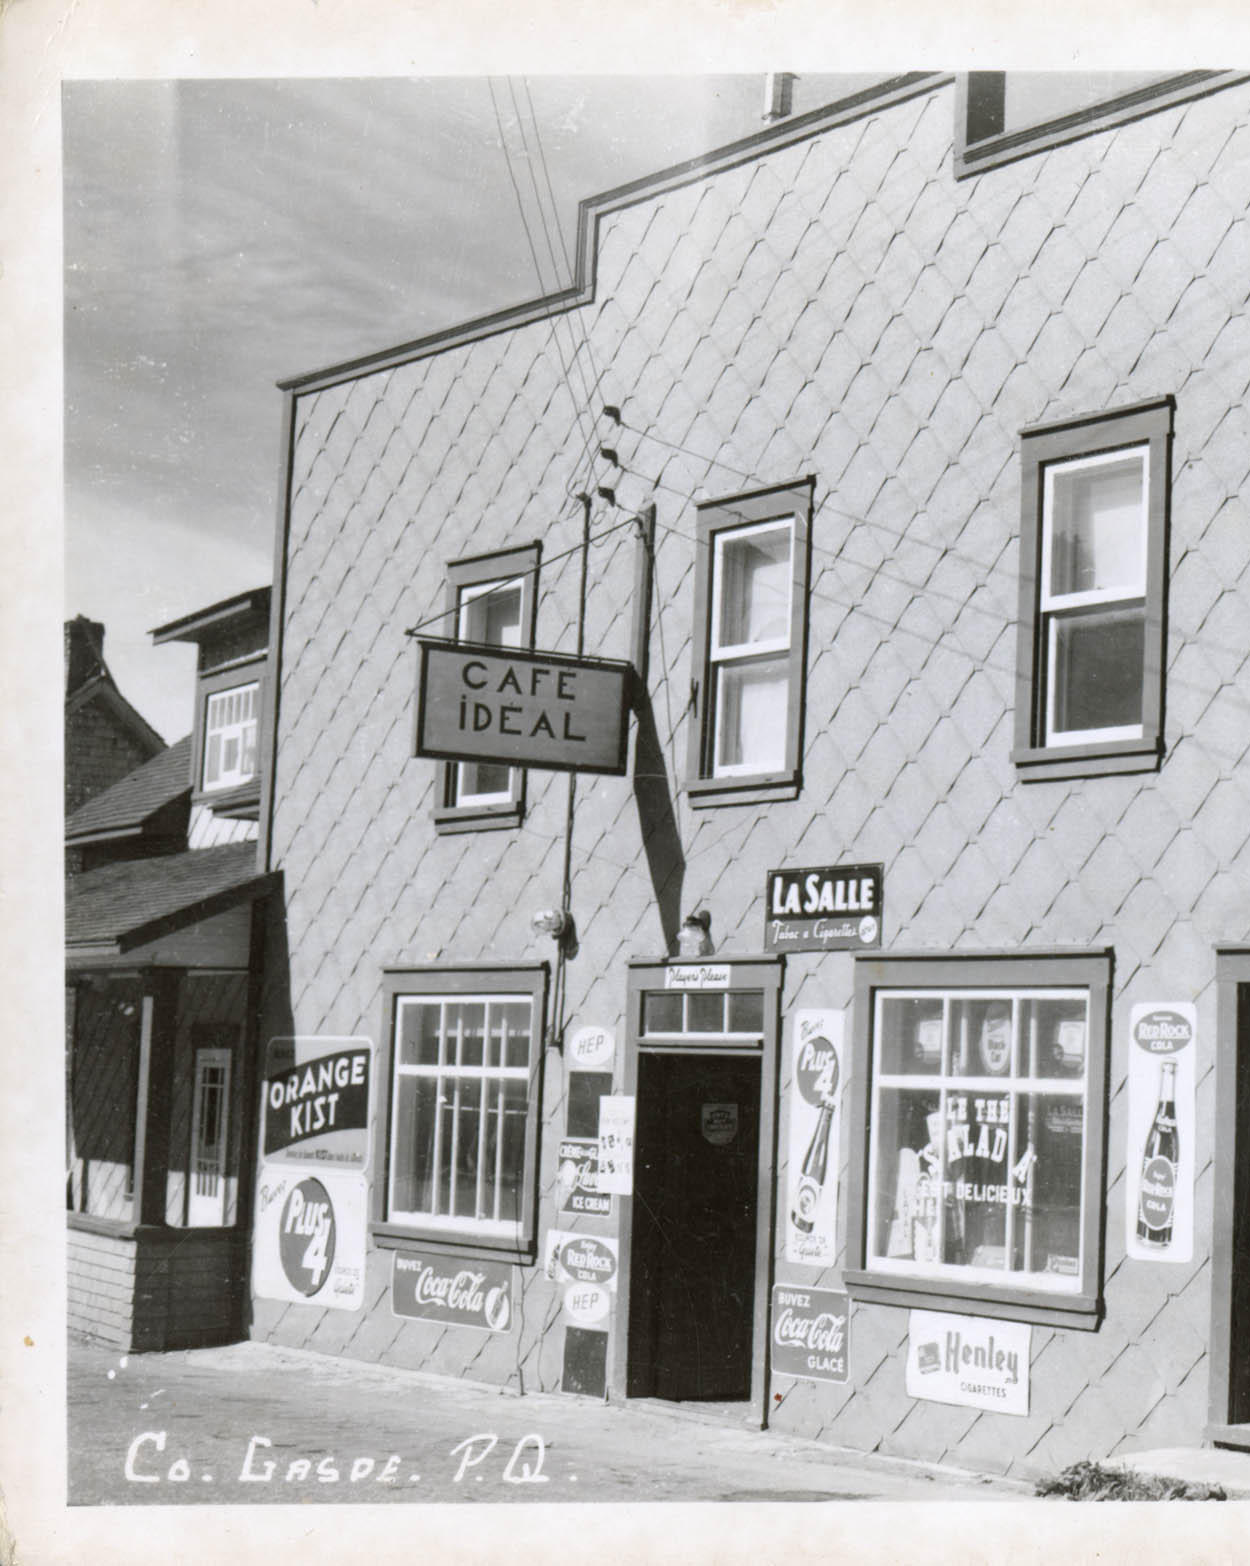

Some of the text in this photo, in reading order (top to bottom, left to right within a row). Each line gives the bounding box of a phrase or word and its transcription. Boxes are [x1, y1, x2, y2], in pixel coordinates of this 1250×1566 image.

[1151, 1040, 1174, 1050] COLA
[270, 1055, 366, 1110] ORANGE
[813, 1058, 836, 1101] 4
[290, 1092, 340, 1138] KIST
[302, 1217, 332, 1287] 4
[415, 1266, 487, 1312] Coca-Cola
[577, 1270, 598, 1282] COLA
[777, 1292, 811, 1309] BUVEZ
[774, 1307, 847, 1353] Coca-Cola
[944, 1330, 1019, 1385] Henley
[960, 1381, 1008, 1399] CIGARETTES
